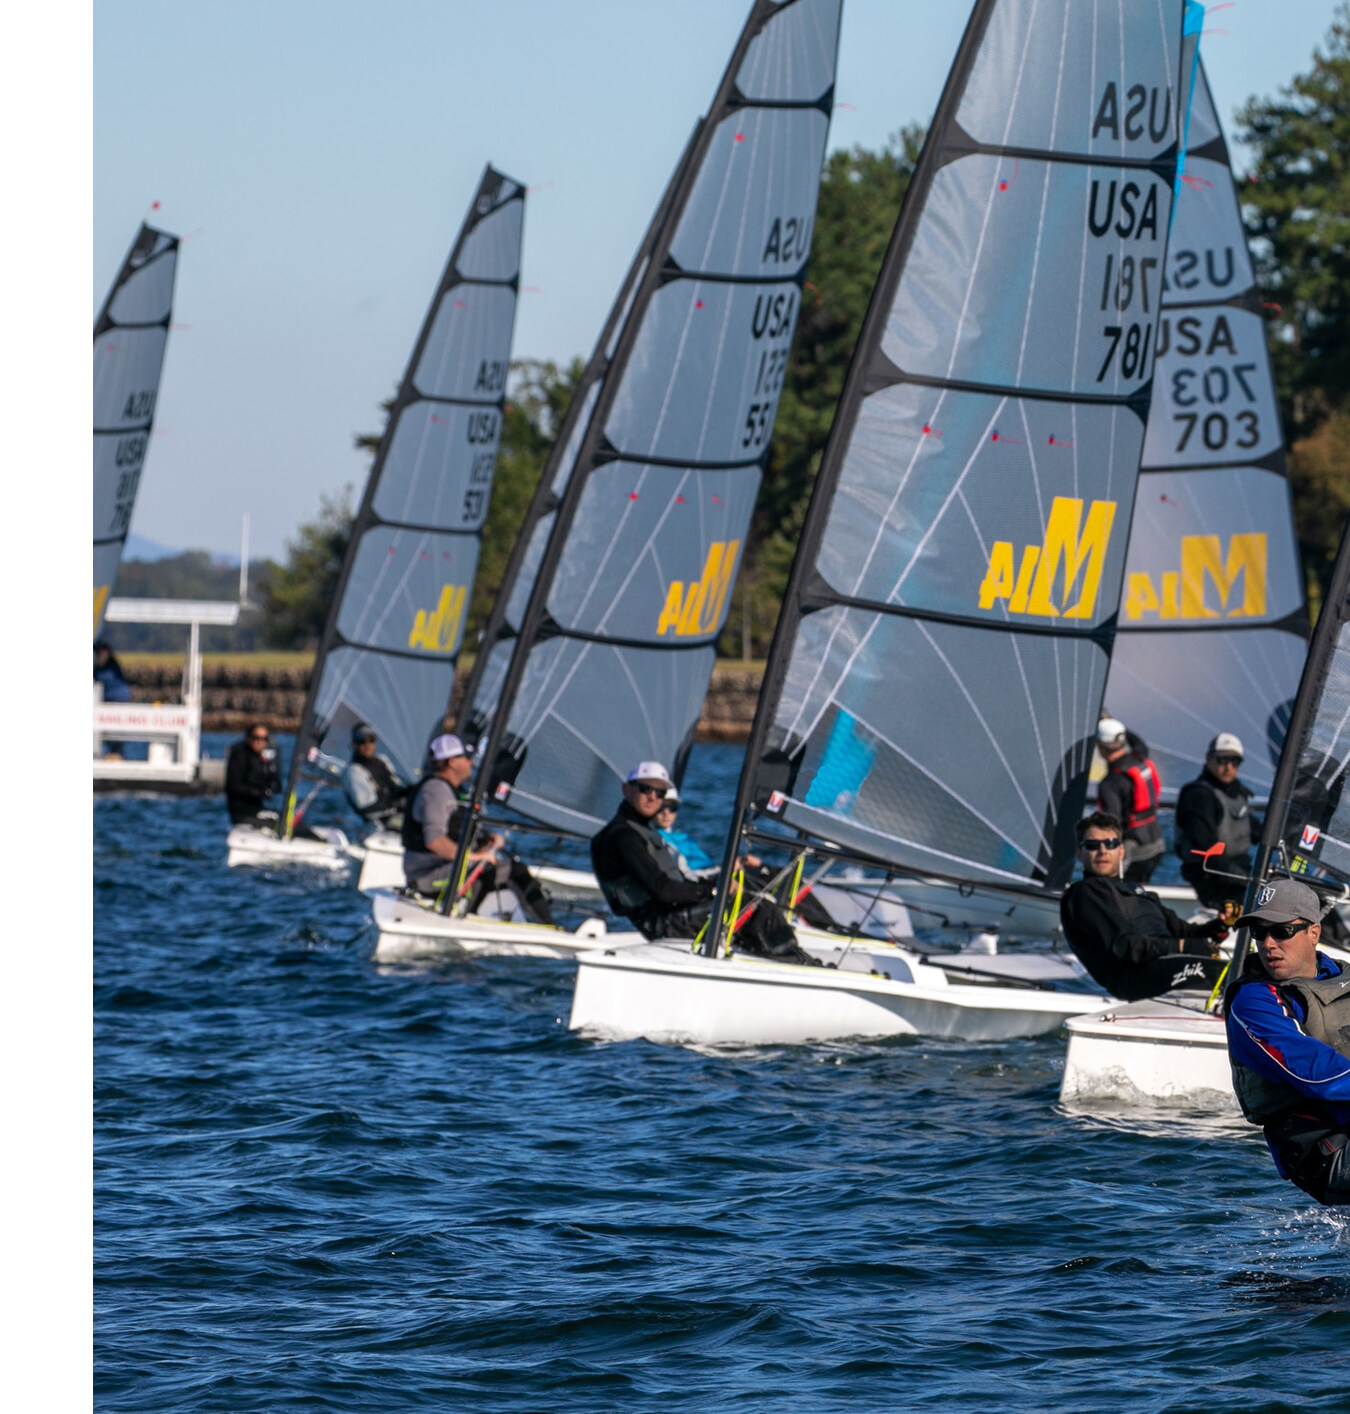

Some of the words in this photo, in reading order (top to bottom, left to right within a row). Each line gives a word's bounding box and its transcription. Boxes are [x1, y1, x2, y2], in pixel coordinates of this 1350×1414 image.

[1088, 180, 1157, 240] USA
[752, 292, 794, 340] USA
[1096, 323, 1152, 382] 781
[1173, 410, 1259, 452] 703
